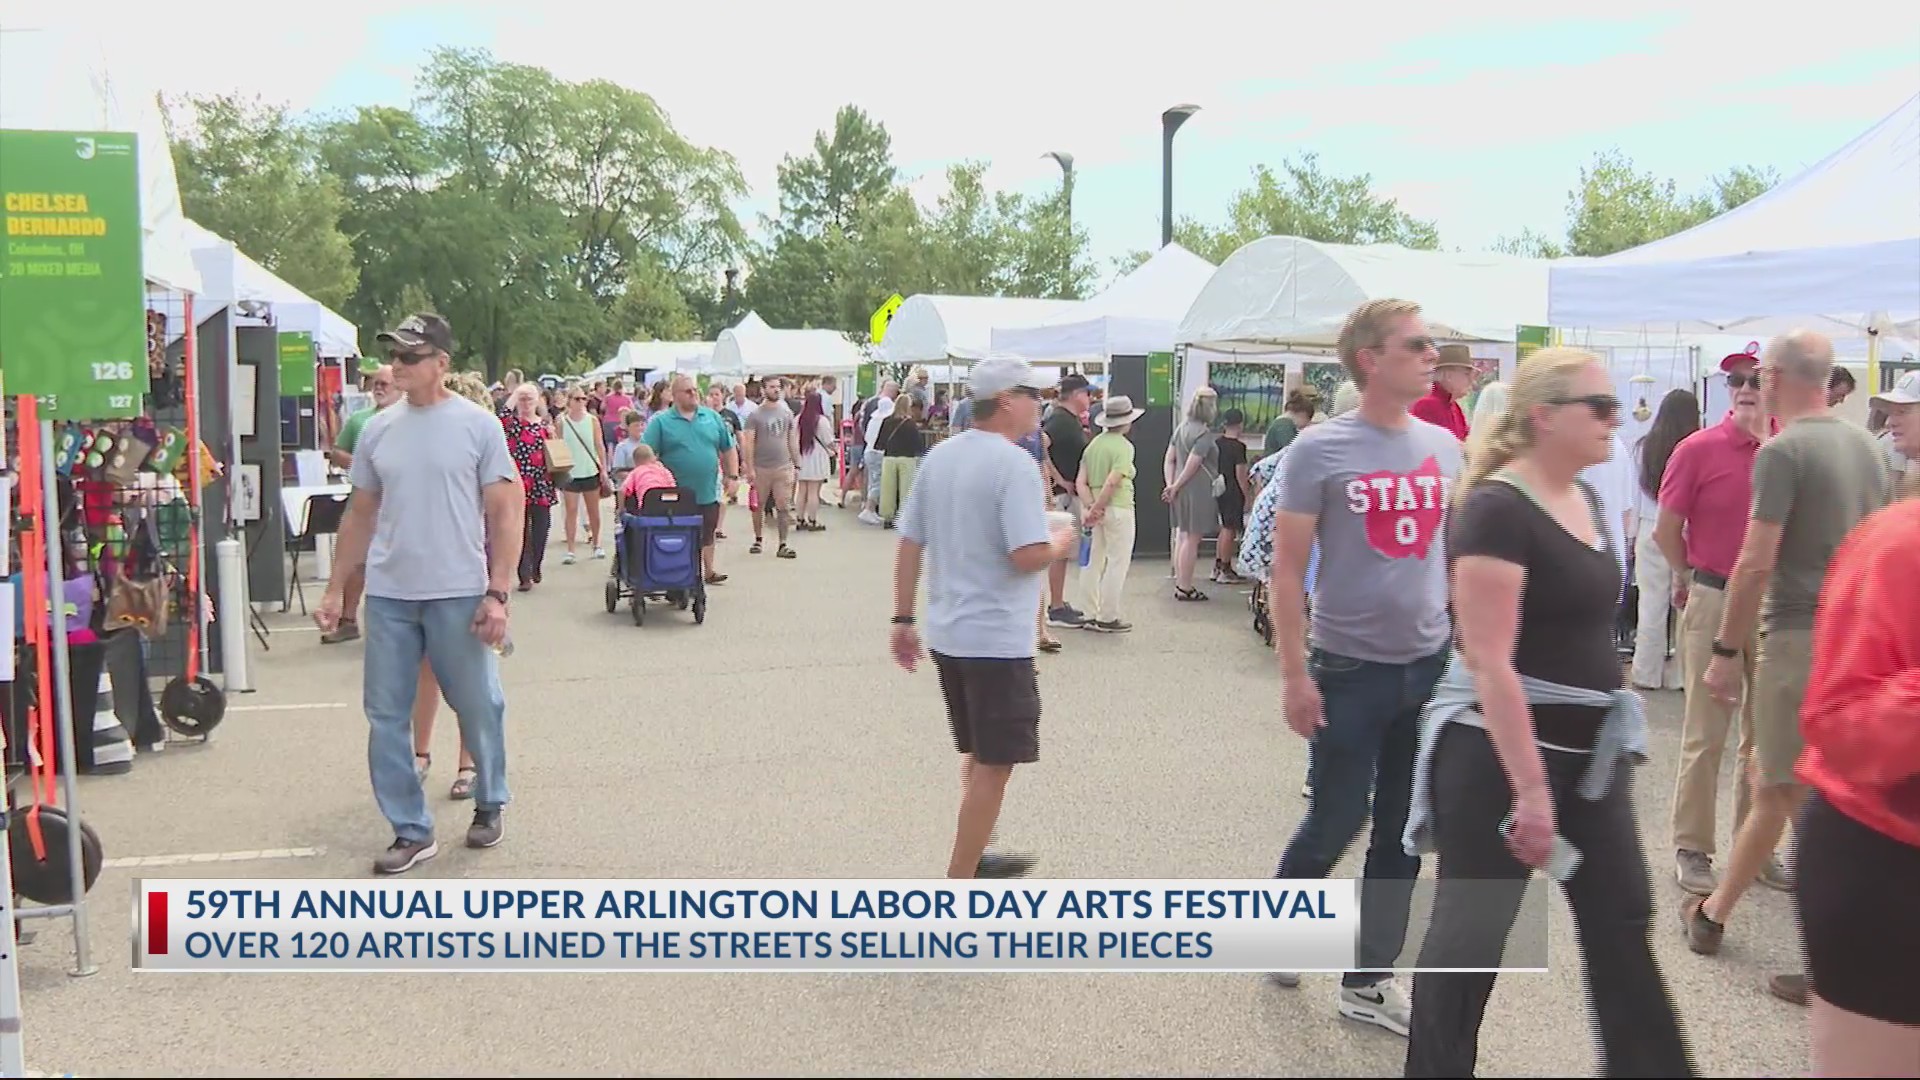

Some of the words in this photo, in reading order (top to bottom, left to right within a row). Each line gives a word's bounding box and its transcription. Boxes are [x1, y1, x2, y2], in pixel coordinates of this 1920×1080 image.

[5, 192, 89, 212] CHELSEA
[7, 216, 107, 236] BERNARDO
[91, 361, 134, 380] 126
[109, 395, 134, 409] 127
[1394, 515, 1420, 545] O
